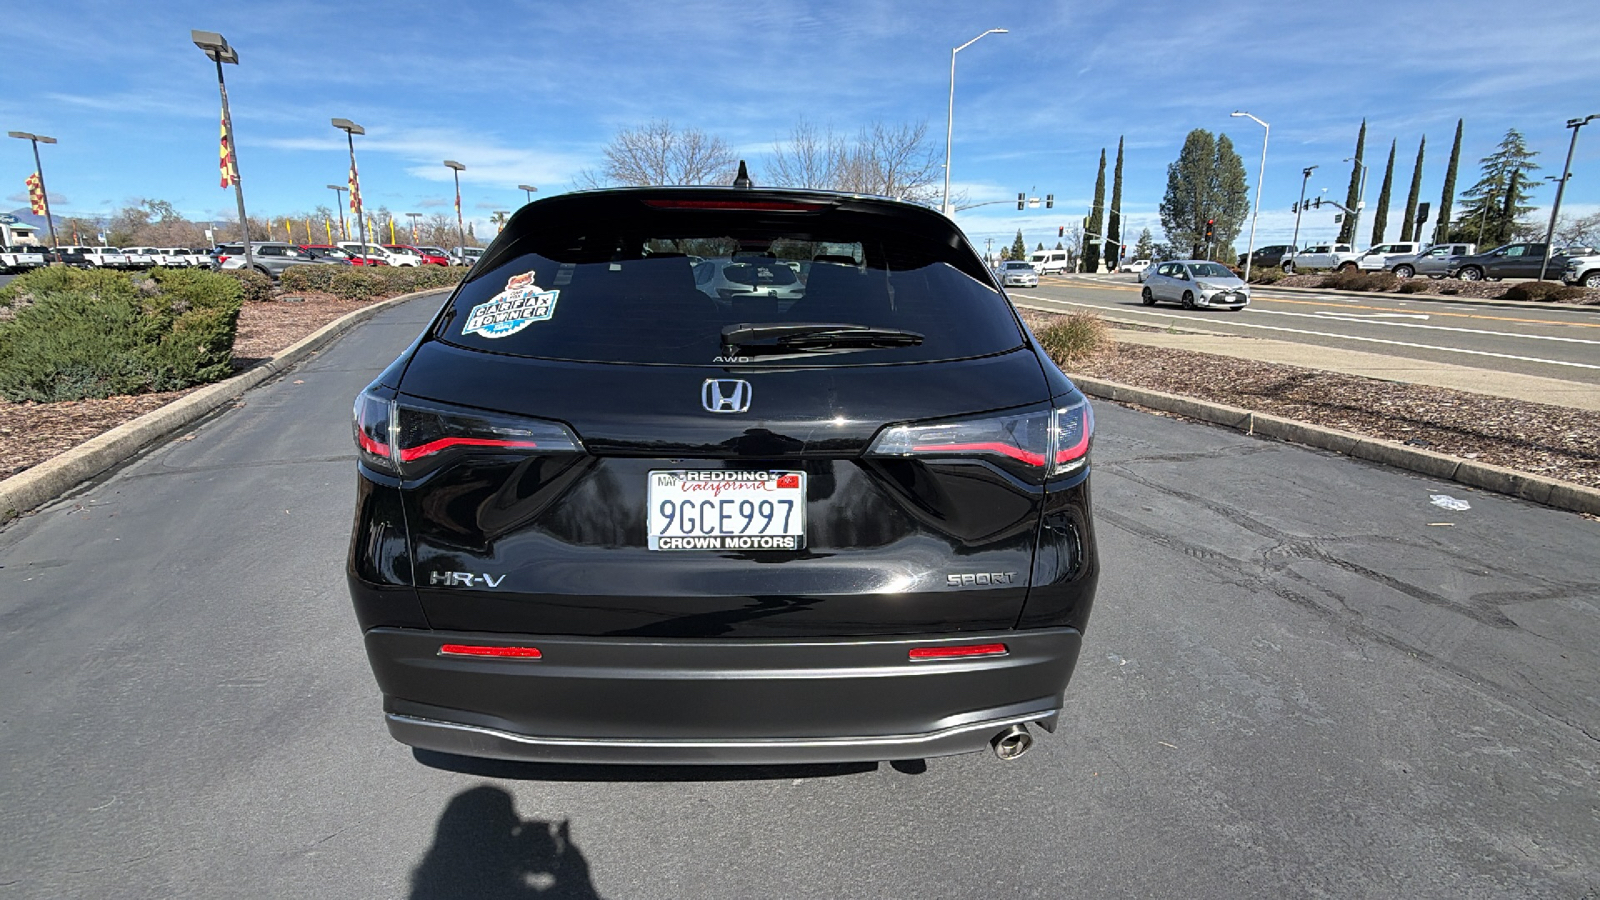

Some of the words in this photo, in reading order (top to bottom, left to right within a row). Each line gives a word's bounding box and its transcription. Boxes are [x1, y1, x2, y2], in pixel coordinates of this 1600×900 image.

[475, 297, 549, 317] CARFAX
[658, 476, 676, 487] MAY
[687, 471, 769, 481] REDDING
[681, 480, 776, 497] California
[659, 499, 794, 535] 9GCE997
[659, 537, 721, 549] CROWN
[725, 537, 795, 549] MOTORS
[429, 571, 506, 588] HR-V
[946, 571, 1018, 587] SPORT
